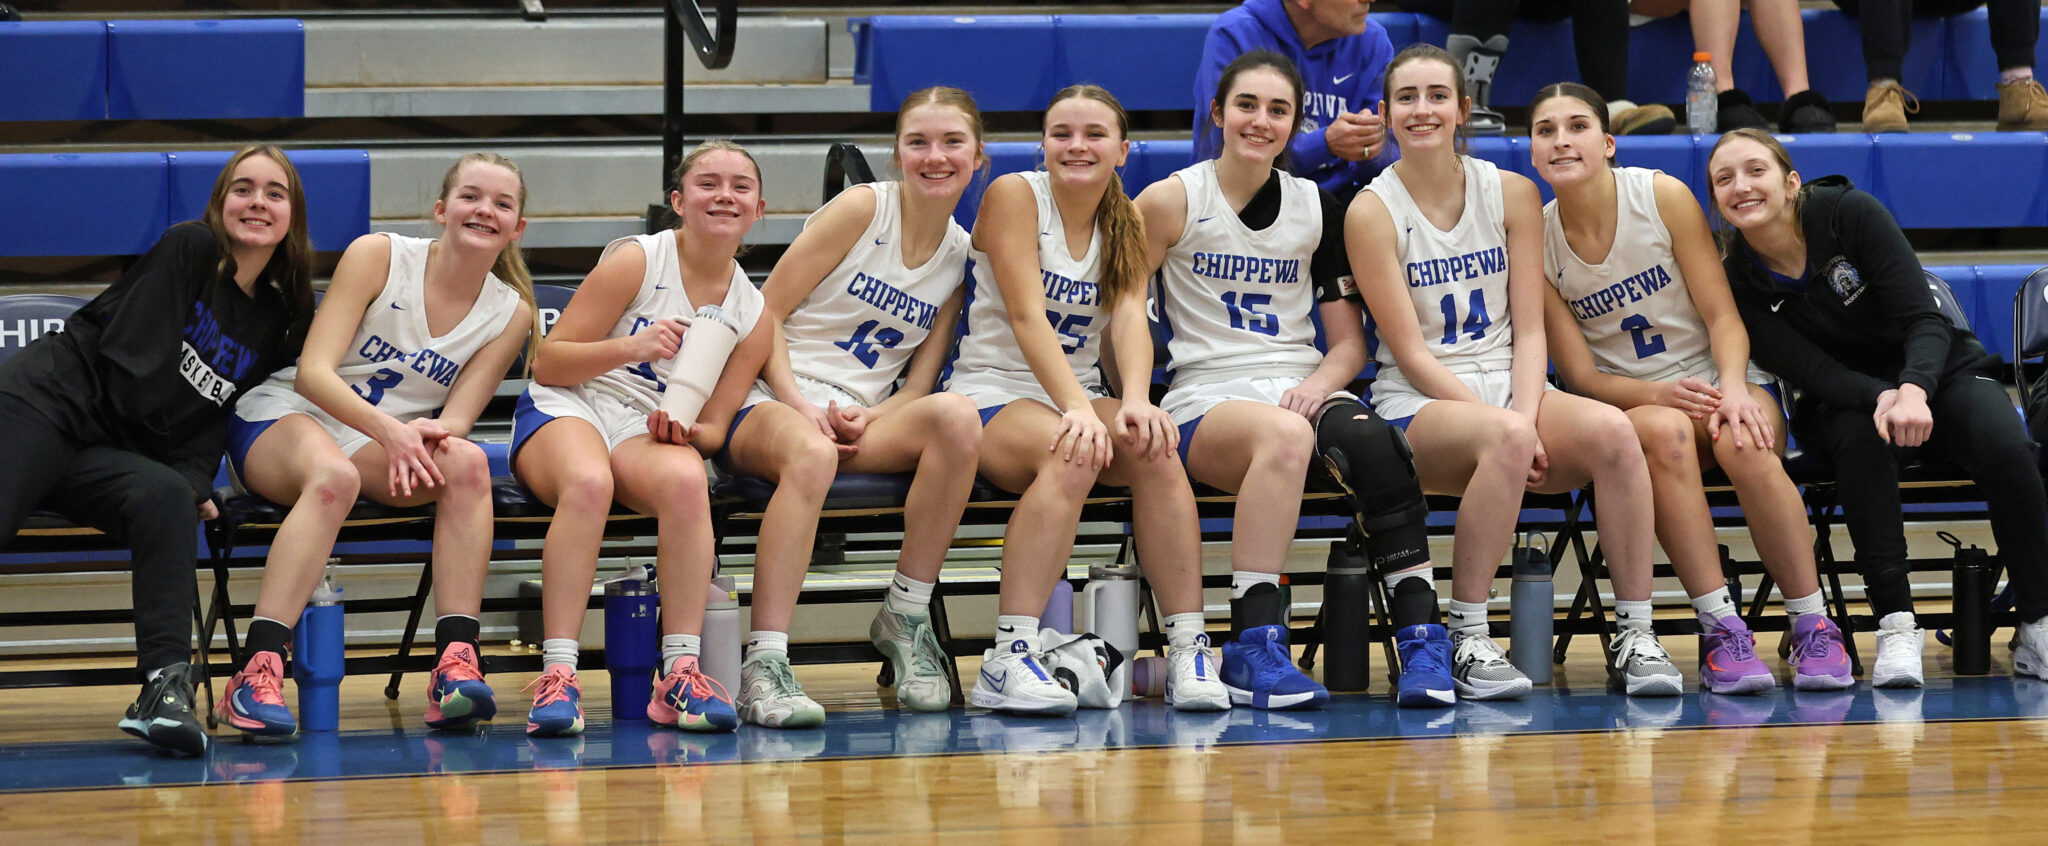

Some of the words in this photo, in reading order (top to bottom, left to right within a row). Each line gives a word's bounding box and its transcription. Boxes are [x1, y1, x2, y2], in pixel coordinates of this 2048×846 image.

[1040, 268, 1101, 307] HIPPE
[1192, 252, 1299, 284] CHIPPEWA
[1407, 246, 1506, 288] CHIPPEWA
[1221, 290, 1279, 337] 15
[1570, 264, 1672, 320] CHIPPEWA
[1440, 288, 1492, 345] 14
[1620, 313, 1667, 360] 2
[833, 319, 904, 370] 12
[350, 367, 404, 407] 3
